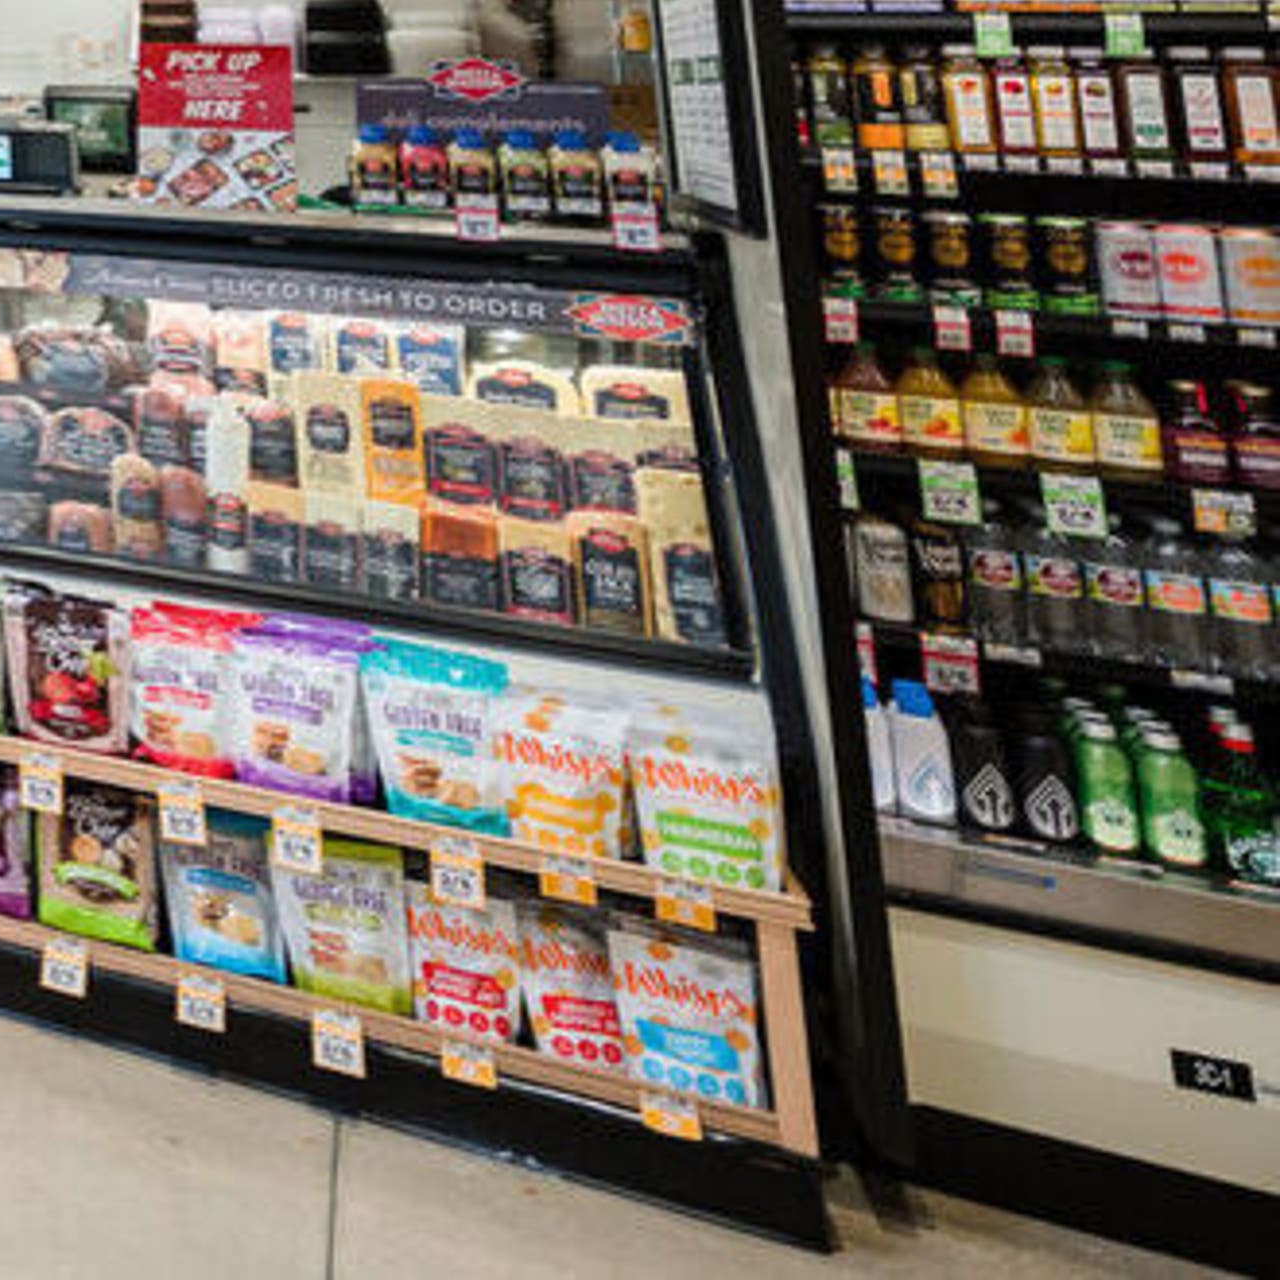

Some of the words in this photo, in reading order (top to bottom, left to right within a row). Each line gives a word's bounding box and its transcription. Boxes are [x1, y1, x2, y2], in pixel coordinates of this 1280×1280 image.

[166, 51, 221, 70] PICK
[227, 52, 263, 70] UP
[184, 100, 245, 120] HERE
[443, 293, 547, 320] ORDER
